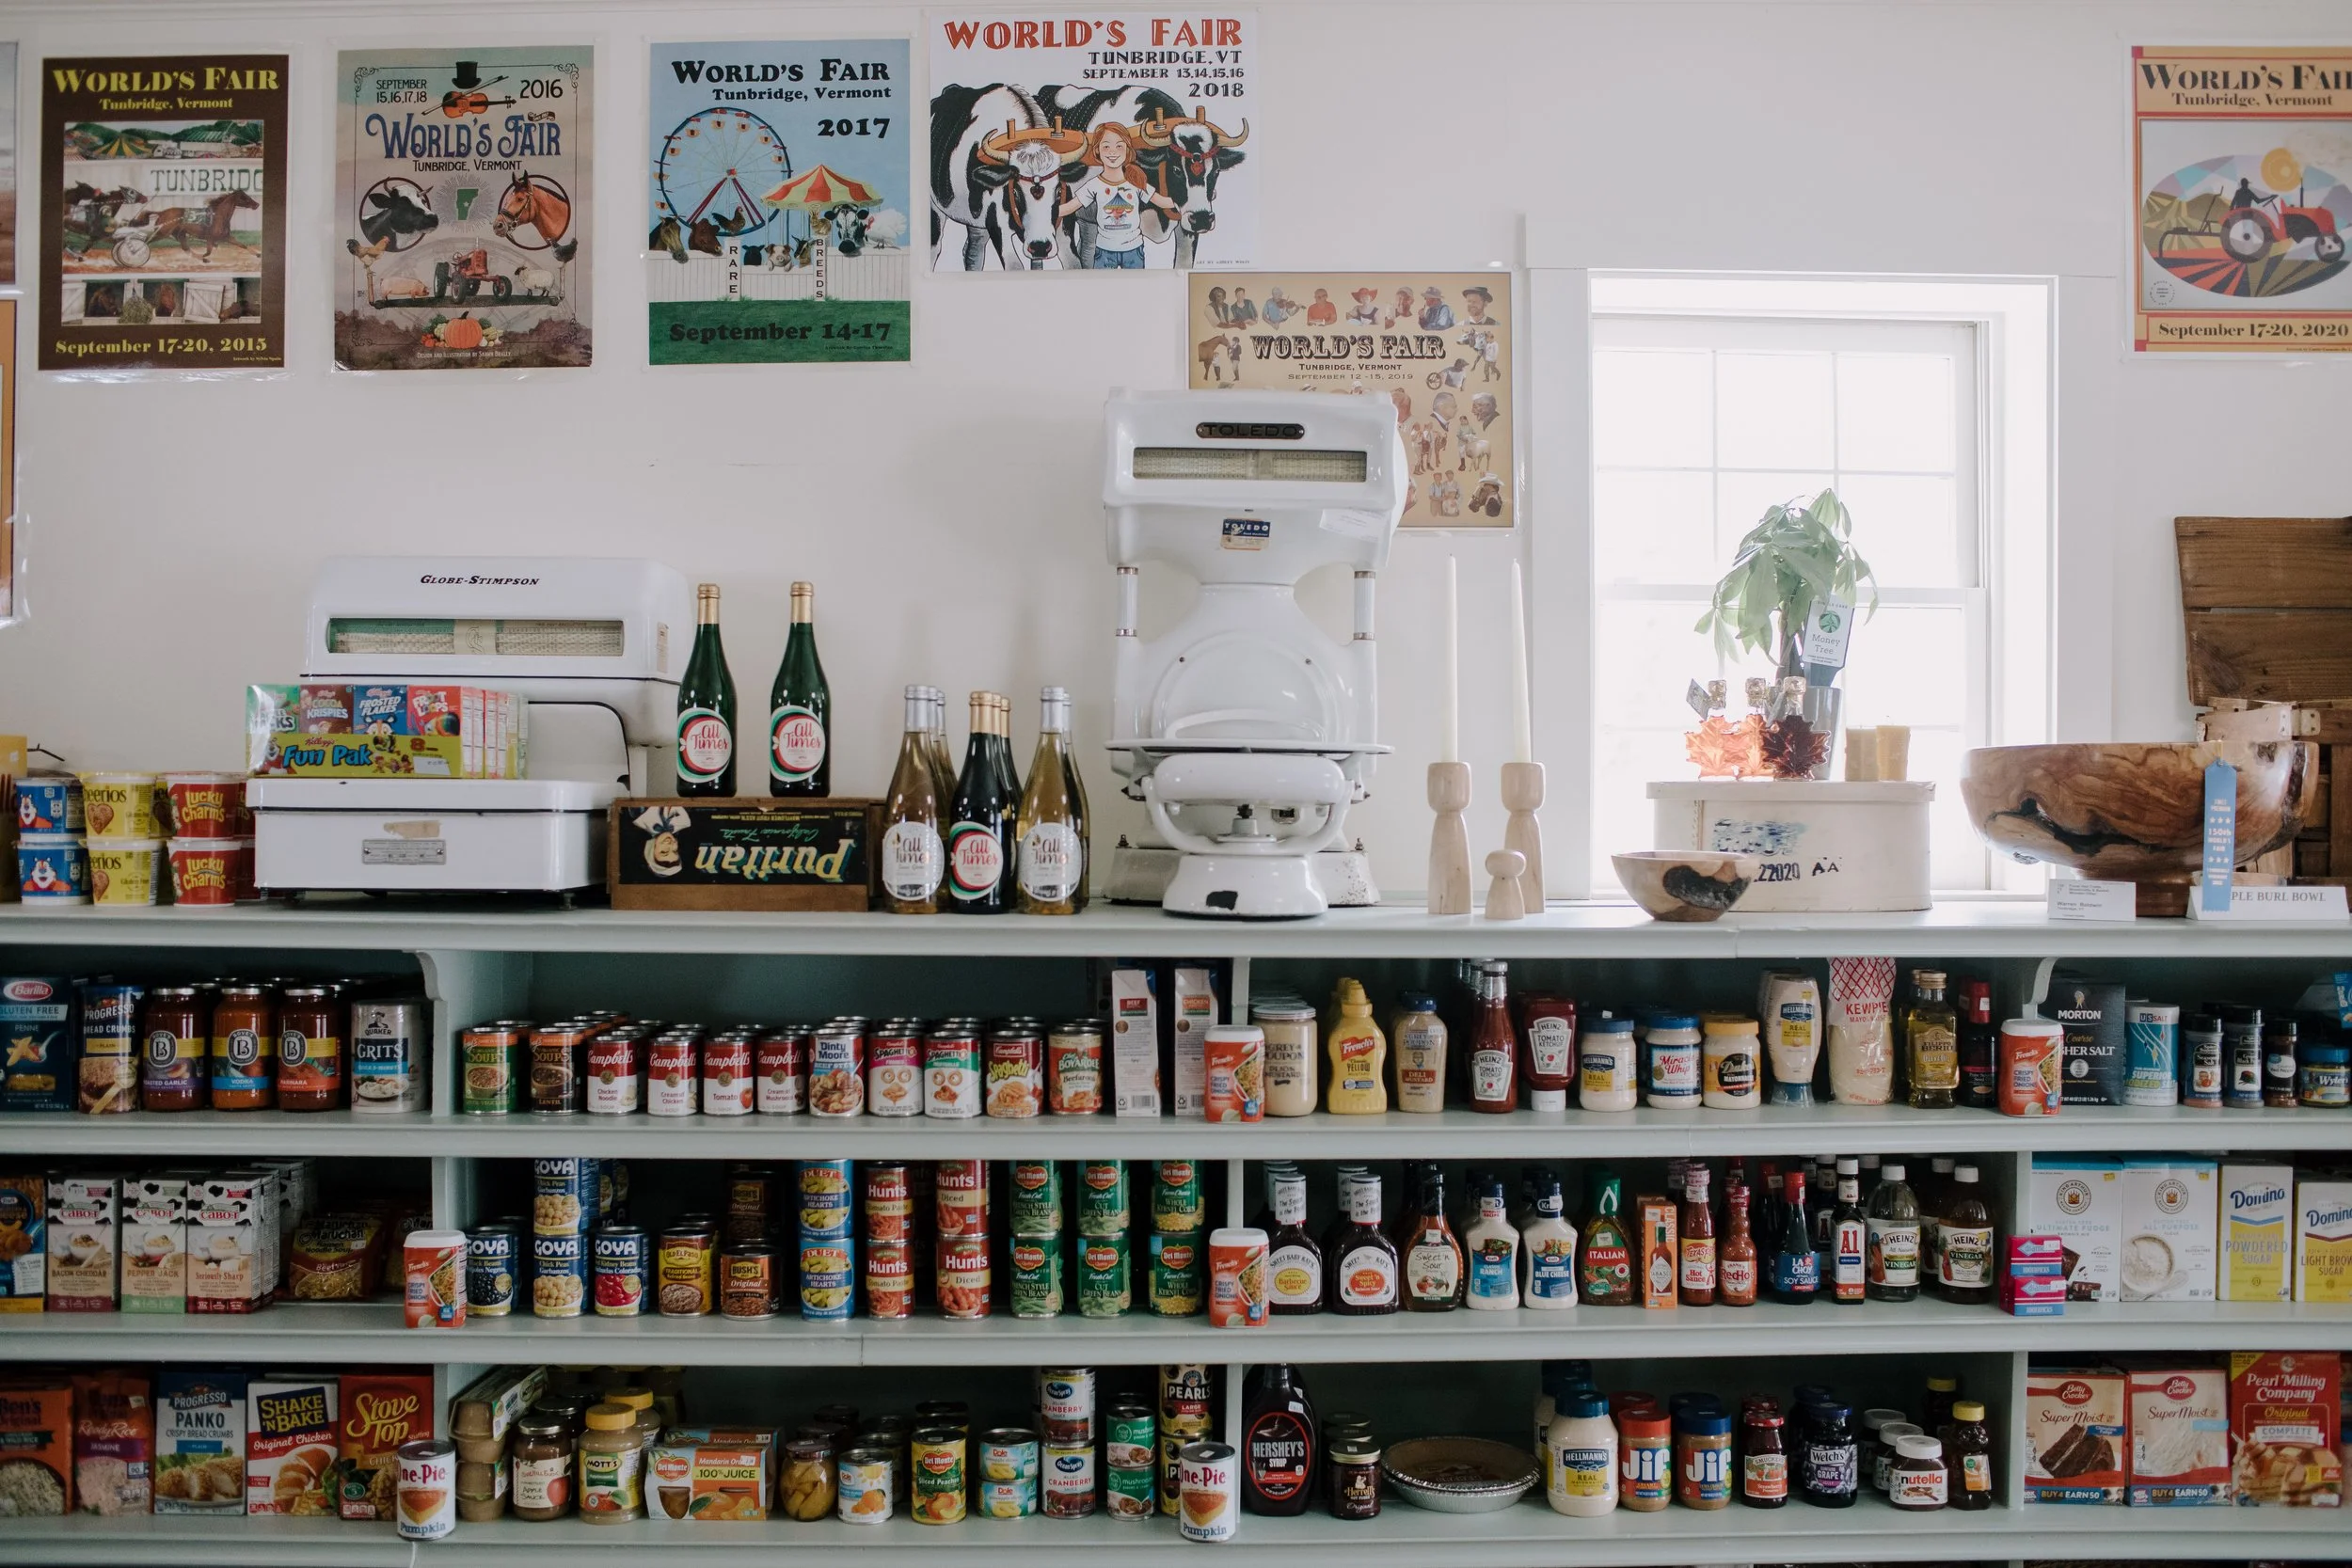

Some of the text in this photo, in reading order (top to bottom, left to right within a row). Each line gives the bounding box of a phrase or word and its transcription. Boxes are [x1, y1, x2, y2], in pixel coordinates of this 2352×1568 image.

[944, 18, 1243, 50] WORLD'S FAIR
[1088, 50, 1242, 65] TUNBRIDGE, VT
[672, 57, 890, 84] WORLD'S FAIR
[1082, 68, 1168, 79] SEPTEMBER
[2140, 64, 2282, 90] WORLD'S
[53, 67, 279, 93] WORLD'S FAIR
[376, 79, 426, 89] SEPTEMBER
[519, 79, 564, 99] 2016
[712, 87, 892, 103] Tunbridge, Vermont
[1188, 83, 1244, 98] 2018
[99, 96, 234, 111] Tunbridge, Vermont
[2171, 92, 2333, 106] Tunbridge, Vermont
[817, 118, 891, 138] 2017
[365, 112, 562, 159] WORLD'S FAIR
[412, 159, 522, 172] TUNBRIDGE, VERMONT
[728, 245, 739, 294] RARE
[816, 238, 824, 298] BREEDS
[669, 322, 891, 344] September 14-17
[2158, 323, 2350, 339] September 17-20, 2020
[56, 337, 268, 357] September 17-20, 2015
[1249, 334, 1447, 359] WORLD'S FAIR
[1298, 363, 1403, 372] TUNBRIDGE, VERMONT
[1202, 424, 1300, 438] TOLEDO
[1224, 522, 1269, 533] TOLEDO
[420, 574, 540, 586] GLOBE-STIMPSON
[1811, 634, 1841, 647] Money
[1814, 644, 1834, 655] Tree
[311, 699, 343, 710] COCOA
[358, 695, 402, 710] FROSTED
[307, 706, 349, 721] KRISPIES
[361, 705, 398, 716] FLAKES
[691, 733, 729, 751] Times
[784, 732, 821, 749] Times
[282, 743, 373, 768] Fun Pak
[185, 790, 224, 806] Lucky
[182, 806, 225, 824] Charms
[187, 858, 224, 873] Lucky
[694, 838, 857, 882] Puritan
[183, 873, 226, 890] Charms
[2257, 892, 2289, 901] BURL
[2292, 892, 2327, 902] BOWL
[14, 985, 49, 995] Barilla
[85, 1003, 135, 1021] PROGRESSO
[1845, 1002, 1888, 1016] KEWPIE
[2058, 1009, 2101, 1020] MORTON
[14, 1023, 40, 1032] PENNE
[1540, 1022, 1563, 1031] HEINZ
[357, 1043, 403, 1061] GRITS
[820, 1041, 847, 1054] Dinty
[1342, 1037, 1375, 1054] French's
[587, 1049, 633, 1066] Campbell's
[704, 1052, 751, 1069] Campbell's
[818, 1050, 850, 1060] Moore
[1479, 1055, 1502, 1065] HEINZ
[1582, 1056, 1614, 1066] HELLMANN'S
[988, 1059, 1030, 1081] Spaghetti
[1058, 1057, 1100, 1070] BOYARDEE
[1664, 1065, 1690, 1076] Whip
[2230, 1187, 2285, 1210] Domino
[1888, 1235, 1915, 1244] HEINZ
[1953, 1236, 1979, 1245] HEINZ
[534, 1240, 579, 1256] GOYA
[595, 1240, 637, 1256] GOYA
[2225, 1241, 2288, 1253] POWDERED
[1589, 1250, 1626, 1259] ITALIAN
[1791, 1257, 1804, 1266] LA
[1950, 1251, 1983, 1260] VINEGAR
[2242, 1254, 2272, 1264] SUGAR
[731, 1264, 759, 1275] BUSH'S
[1884, 1259, 1917, 1269] VINEGAR
[2318, 1266, 2344, 1276] SUGAR
[195, 1272, 244, 1282] Seriously Sharp
[730, 1279, 762, 1289] Original
[955, 1275, 981, 1284] Diced
[2247, 1372, 2327, 1389] Pearl Milling
[174, 1391, 227, 1409] PROGRESSO
[1168, 1386, 1211, 1400] PEARLS
[2255, 1386, 2316, 1402] Company
[260, 1394, 324, 1418] SHAKE
[2264, 1406, 2310, 1420] Original
[175, 1412, 225, 1429] PANKO
[275, 1409, 326, 1433] BAKE
[346, 1392, 420, 1437] Stove
[166, 1429, 234, 1439] CRISPY BREAD CRUMBS
[372, 1419, 409, 1449] Top
[2262, 1427, 2312, 1436] COMPLETE
[90, 1442, 120, 1452] JASMINE
[254, 1433, 332, 1452] Original Chicken
[1252, 1441, 1305, 1458] HERSHEY'S
[699, 1457, 728, 1466] Mandarin
[1268, 1458, 1287, 1467] SYRUP
[1565, 1452, 1608, 1462] HELLMANN'S
[1811, 1450, 1845, 1462] Welch's
[1623, 1448, 1671, 1481] Jif
[1685, 1449, 1732, 1482] Jif
[698, 1468, 755, 1480] 100% JUICE
[1577, 1473, 1597, 1481] REAL
[1817, 1471, 1839, 1481] GRAPE
[1900, 1474, 1943, 1485] nutella
[1048, 1477, 1092, 1487] CRANBERRY
[400, 1521, 446, 1536] Pumpkin
[1183, 1521, 1227, 1538] Pumpkin
